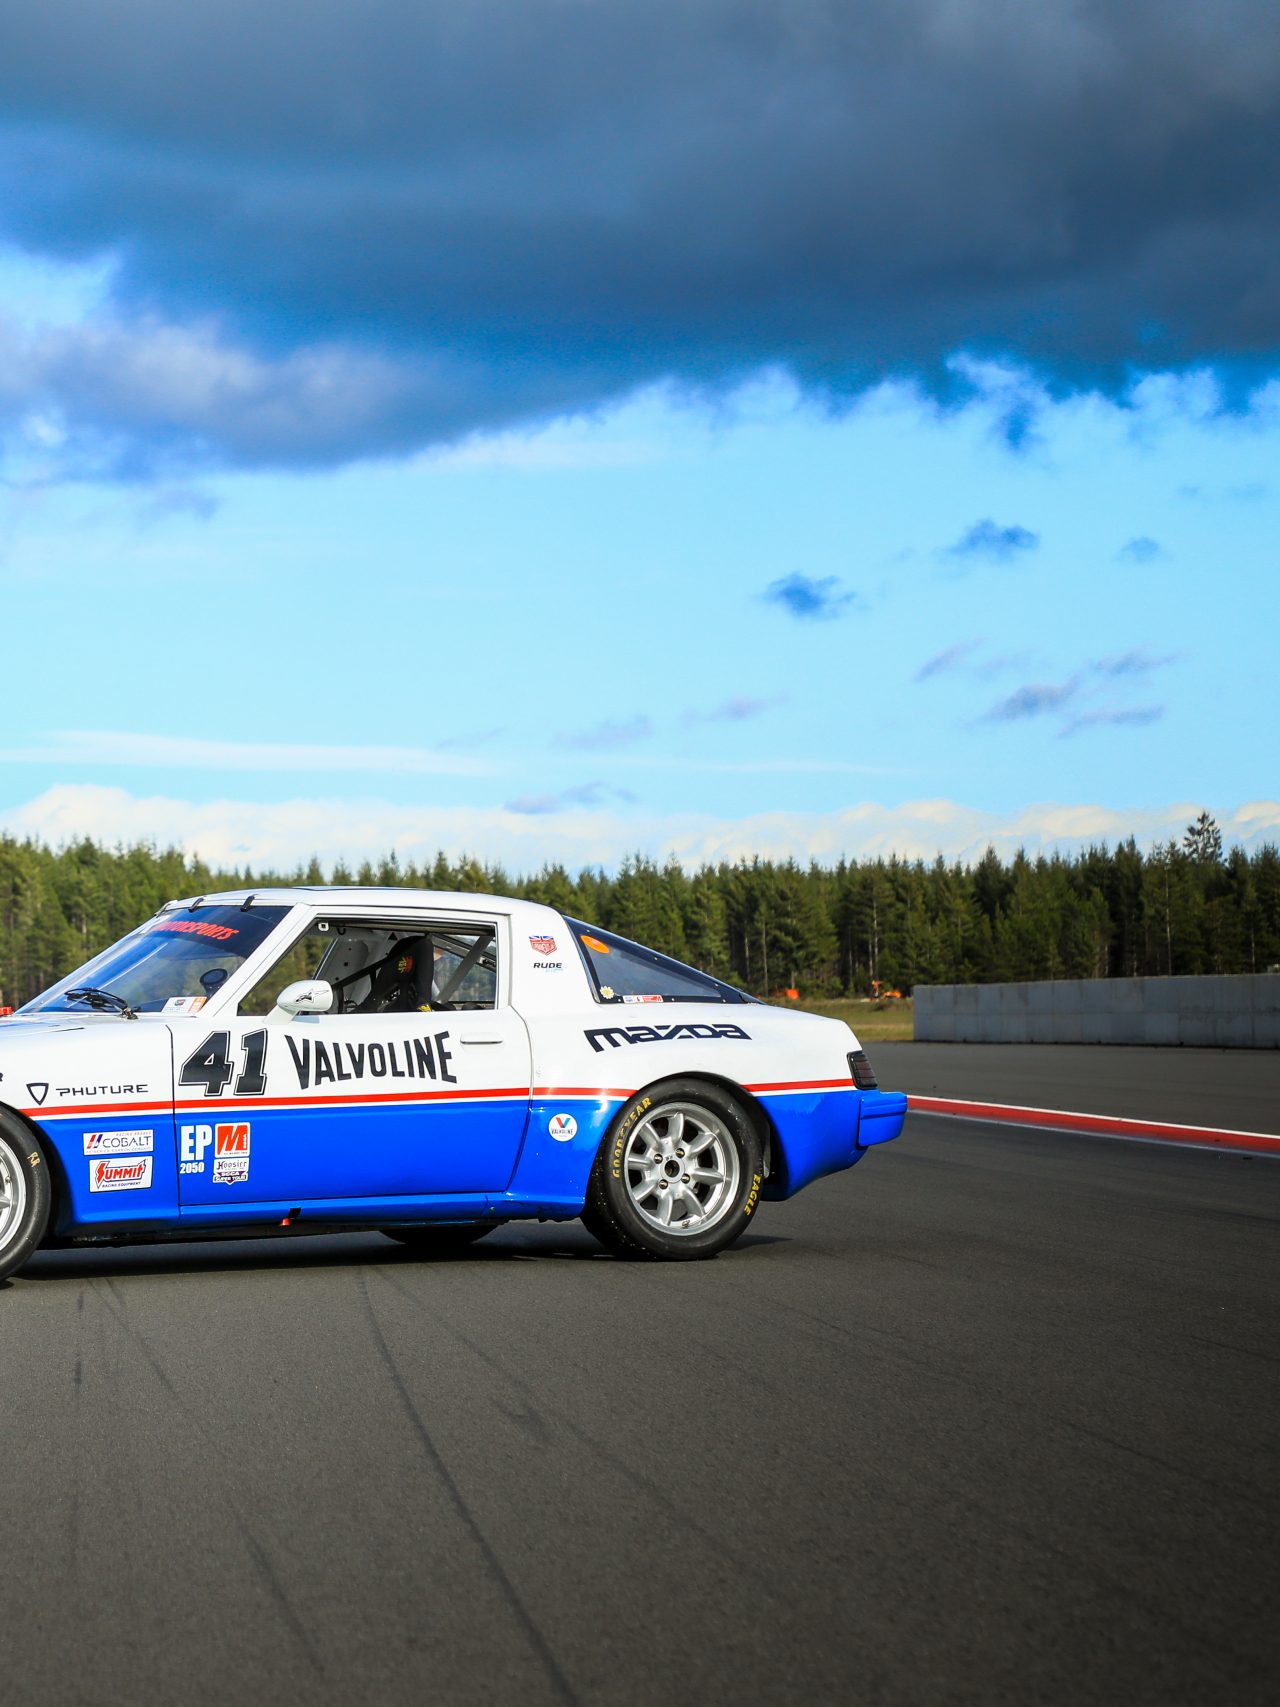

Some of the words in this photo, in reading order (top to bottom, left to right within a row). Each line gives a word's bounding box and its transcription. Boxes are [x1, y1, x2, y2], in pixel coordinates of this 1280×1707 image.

[178, 1027, 268, 1097] 41
[284, 1030, 458, 1090] VALVOLINE
[55, 1083, 149, 1098] PHUTURE
[102, 1136, 152, 1149] COBALT
[180, 1124, 213, 1162] EP
[180, 1161, 205, 1175] 2050
[216, 1159, 248, 1170] Hoosier
[743, 1174, 762, 1216] EAGLE
